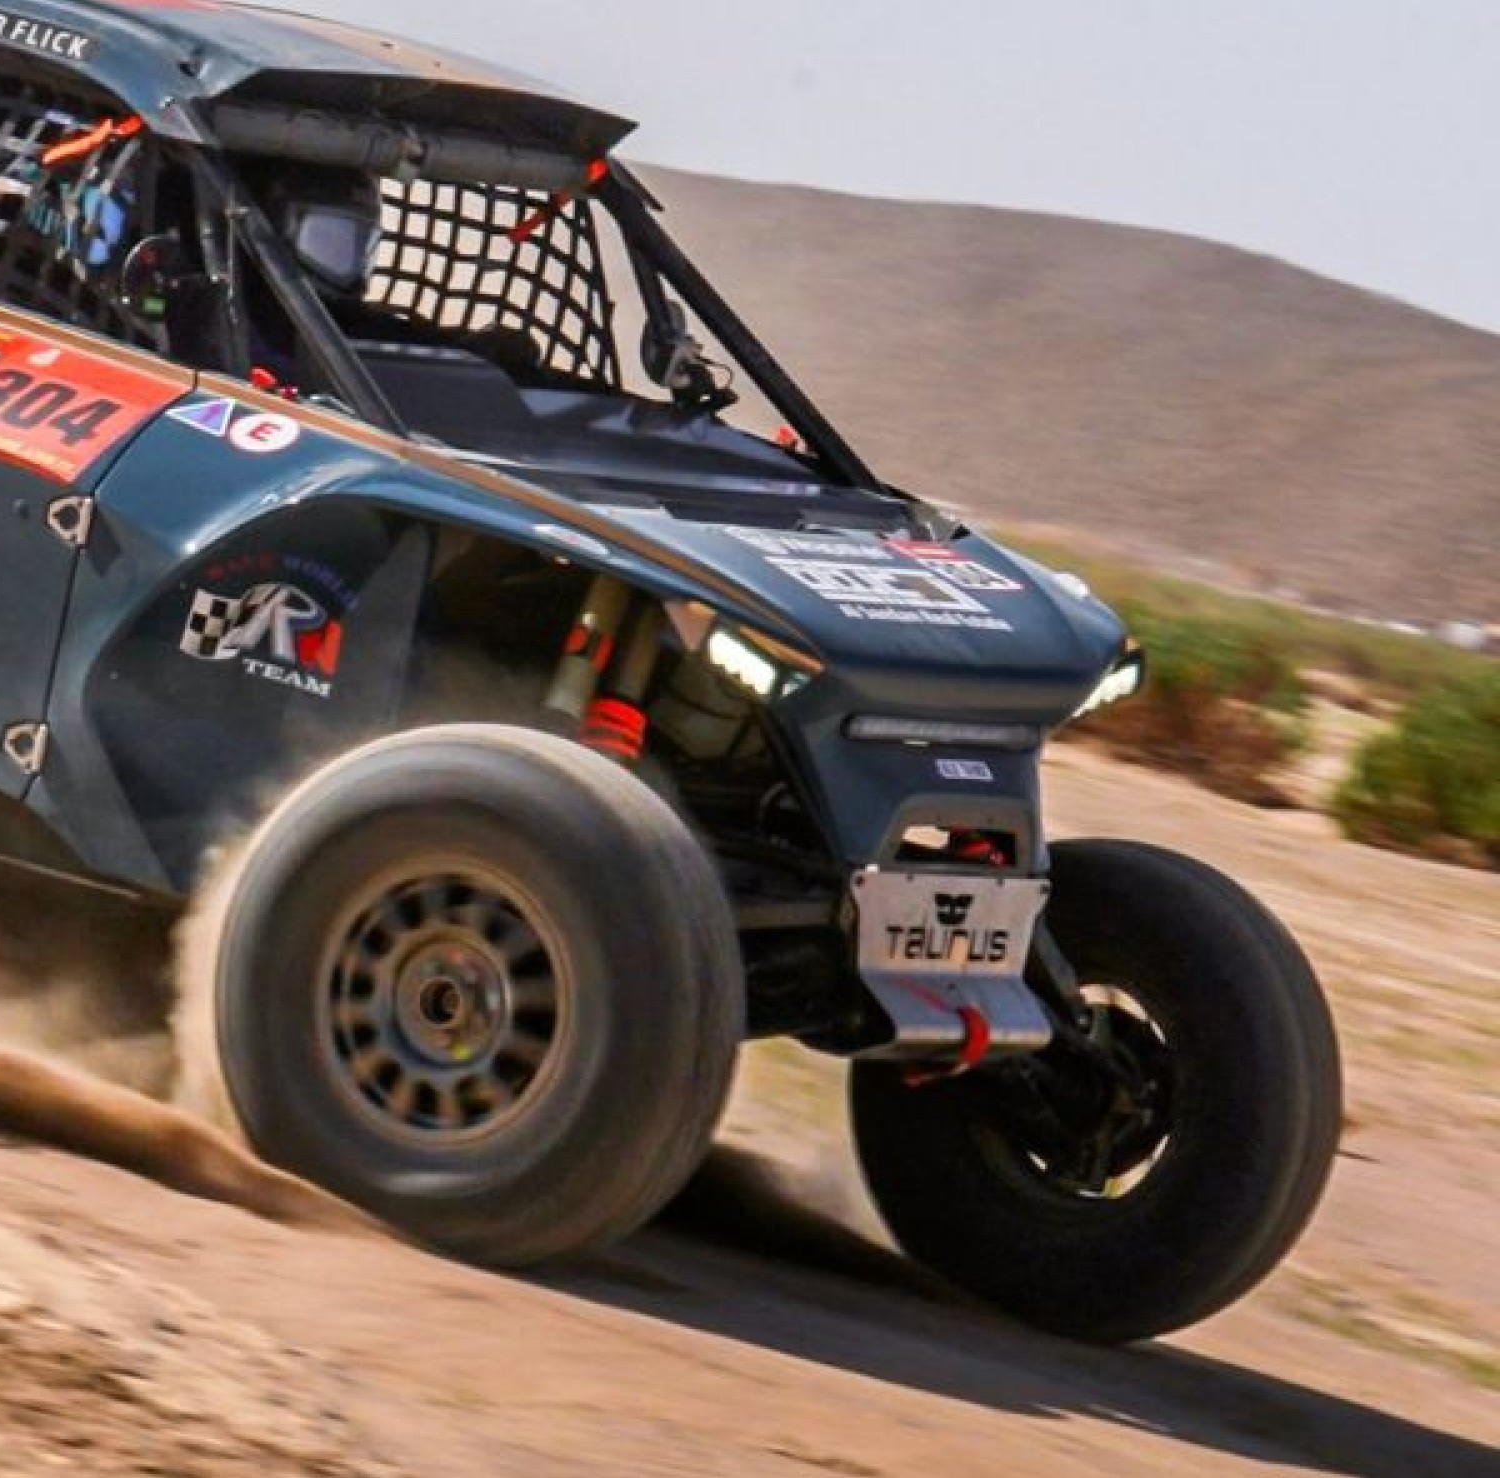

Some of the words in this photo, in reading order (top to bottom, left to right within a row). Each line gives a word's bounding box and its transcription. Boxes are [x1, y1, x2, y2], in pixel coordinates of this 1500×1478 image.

[10, 18, 89, 60] FLICK
[246, 422, 281, 443] E
[243, 658, 331, 697] TEAM
